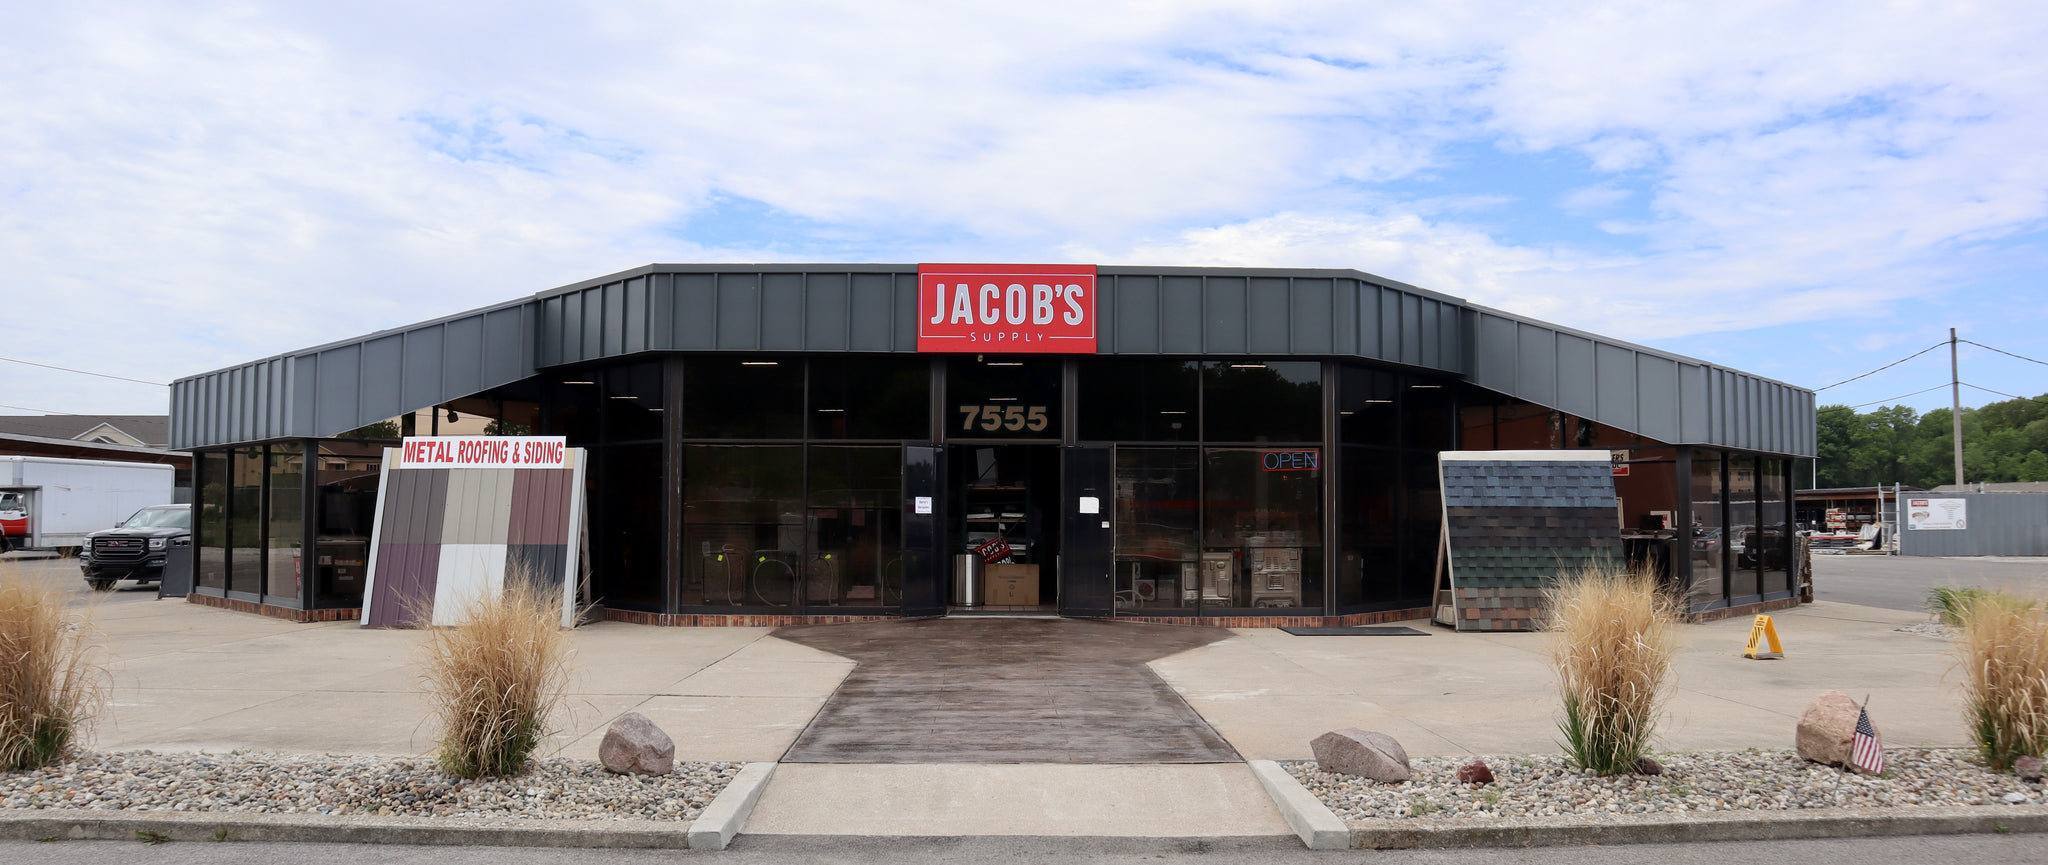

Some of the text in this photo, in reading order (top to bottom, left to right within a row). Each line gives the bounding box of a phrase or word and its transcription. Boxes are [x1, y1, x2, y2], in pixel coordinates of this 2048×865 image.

[931, 283, 1084, 326] JACOB'S
[970, 332, 1045, 342] SUPPLY
[960, 405, 1048, 432] 7555
[403, 440, 563, 464] METAL ROOFING & SIDING
[1264, 452, 1318, 470] OPEN
